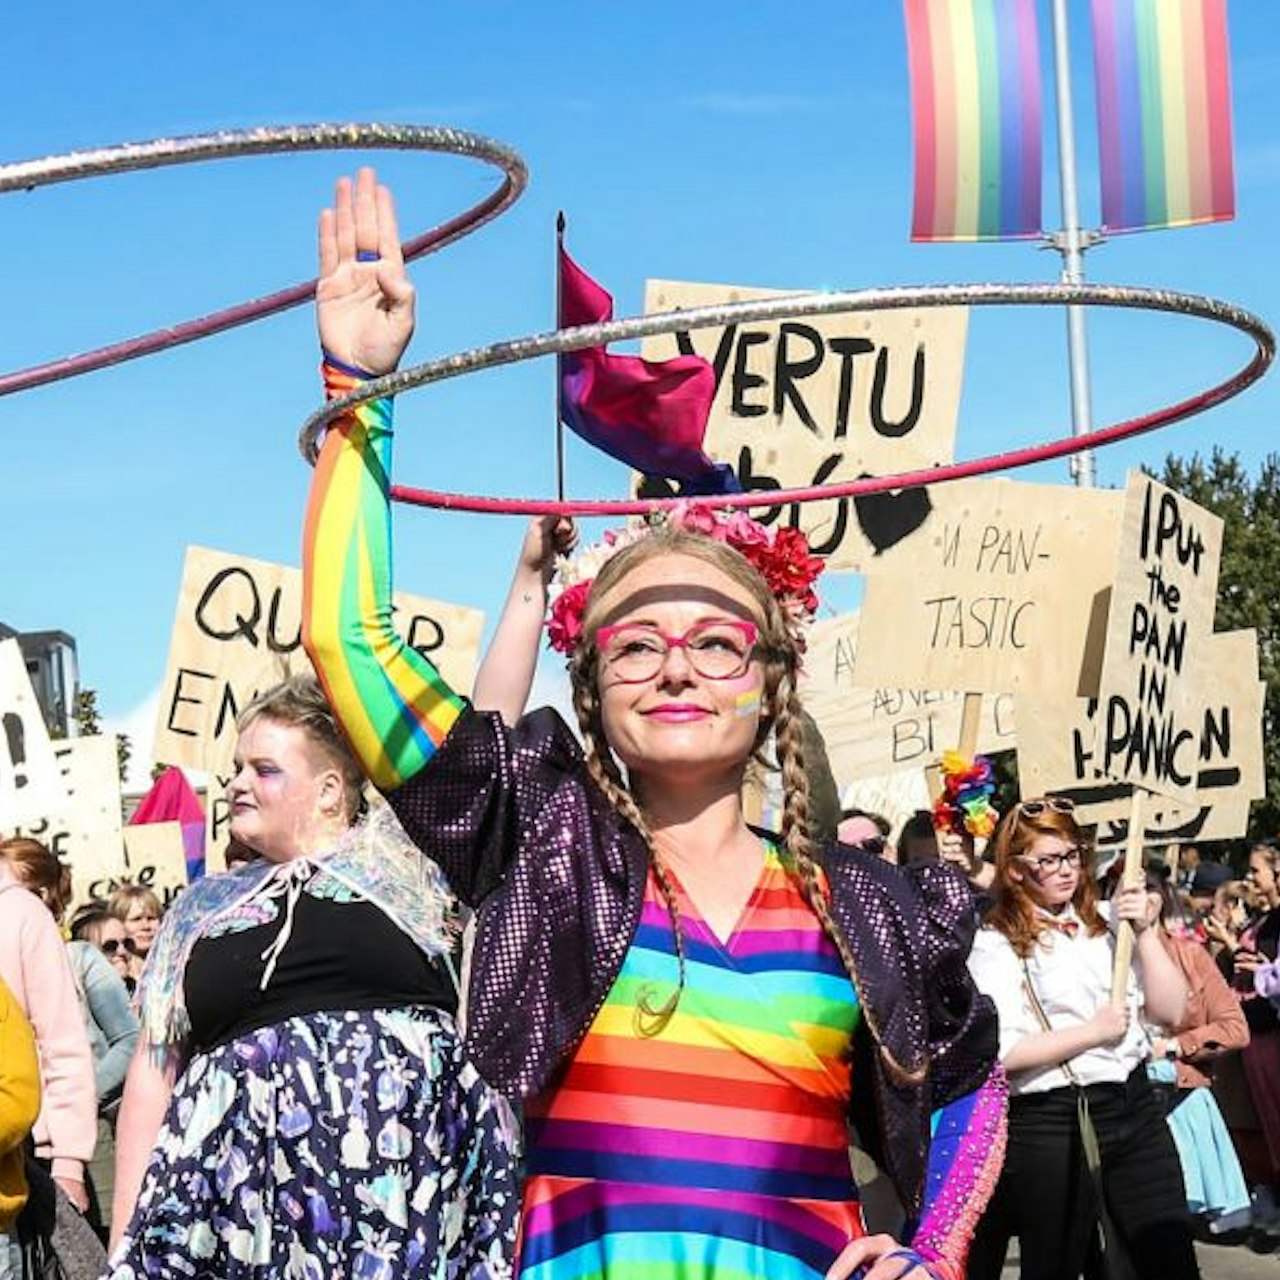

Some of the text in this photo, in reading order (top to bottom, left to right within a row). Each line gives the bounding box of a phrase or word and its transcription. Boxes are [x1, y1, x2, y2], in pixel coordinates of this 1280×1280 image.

[675, 320, 925, 440] VERTU
[976, 524, 1052, 575] PAN-
[1139, 478, 1152, 561] I
[194, 566, 446, 675] QUR
[924, 596, 1036, 650] TASTIC
[1146, 564, 1181, 614] the
[1129, 602, 1188, 676] PAN
[1138, 662, 1168, 714] IN
[1103, 694, 1195, 788] PANIC
